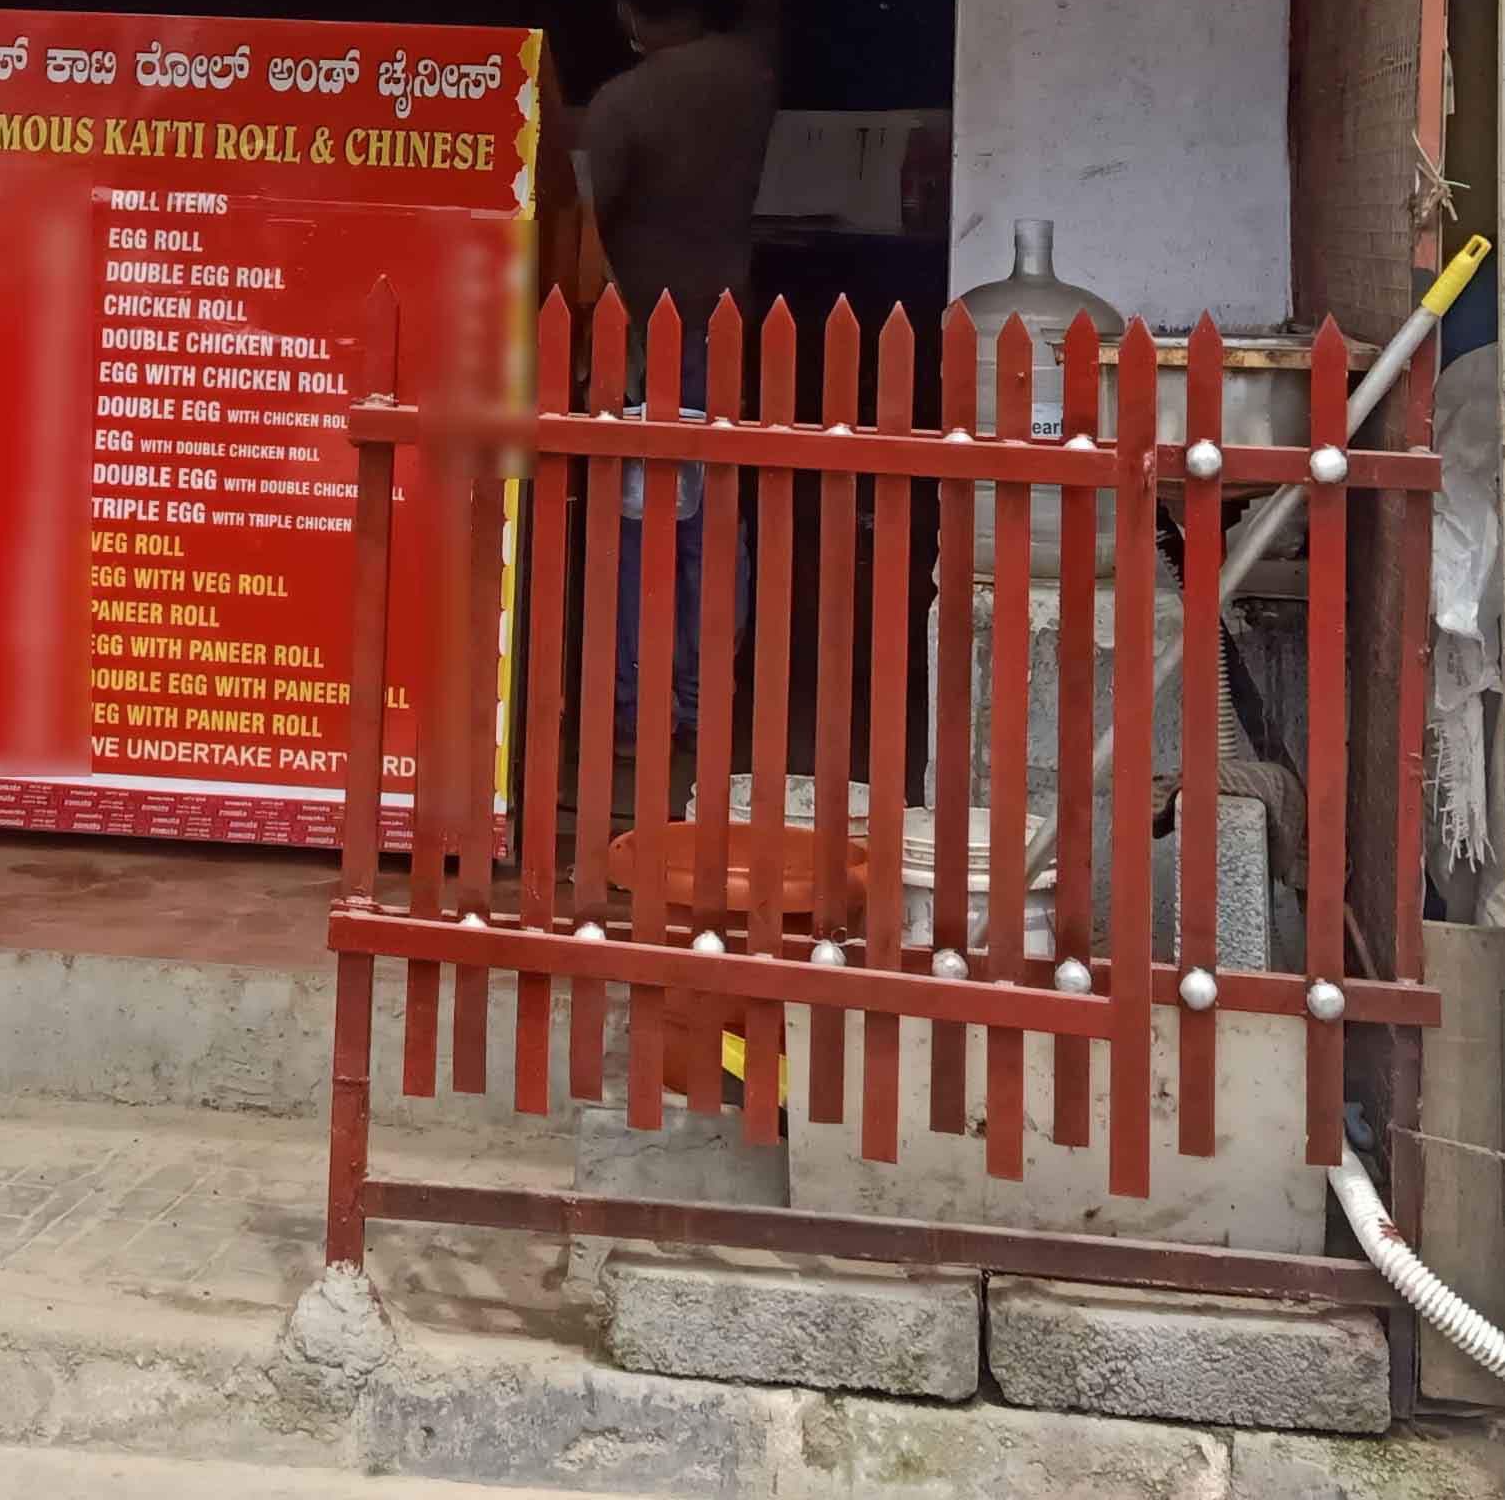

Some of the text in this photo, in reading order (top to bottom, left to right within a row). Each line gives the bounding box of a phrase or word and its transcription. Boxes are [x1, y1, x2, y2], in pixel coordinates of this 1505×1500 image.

[46, 46, 117, 85] ಕಾಟಿ
[135, 41, 251, 89] ರೋಲ್
[269, 49, 360, 94] ಅಂಡ್
[378, 50, 502, 119] ಚೈನೀಸ್
[103, 115, 206, 160] KATTI
[215, 123, 301, 165] ROLL
[310, 128, 336, 165] &
[344, 128, 495, 172] CHINESE
[110, 189, 228, 214] ROLL ITEMS
[109, 227, 204, 253] EGG ROLL
[106, 261, 285, 290] DOUBLE EGG ROLL
[104, 294, 248, 322] CHICKEN ROLL
[102, 328, 330, 360] DOUBLE CHICKEN ROLL
[99, 361, 348, 395] EGG WITH CHICKEN ROLL
[97, 395, 320, 428] DOUBLE EGG WITH CHICKEN
[94, 429, 320, 462] EGG WITH DOUBLE CHICKEN ROLL
[92, 463, 310, 496] DOUBLE EGG WITH DOUBLE
[91, 497, 352, 532] TRIPLE EGG WITH TRIPLE CHICKEN
[134, 533, 185, 557] ROLL
[133, 567, 288, 597] WITH VEG ROLL
[170, 603, 220, 628] ROLL
[130, 635, 324, 669] WITH PANEER ROLL
[168, 672, 351, 705] EGG WITH PANEER
[126, 704, 323, 738] WITH PANNER ROLL
[126, 738, 272, 768] UNDERTAKE
